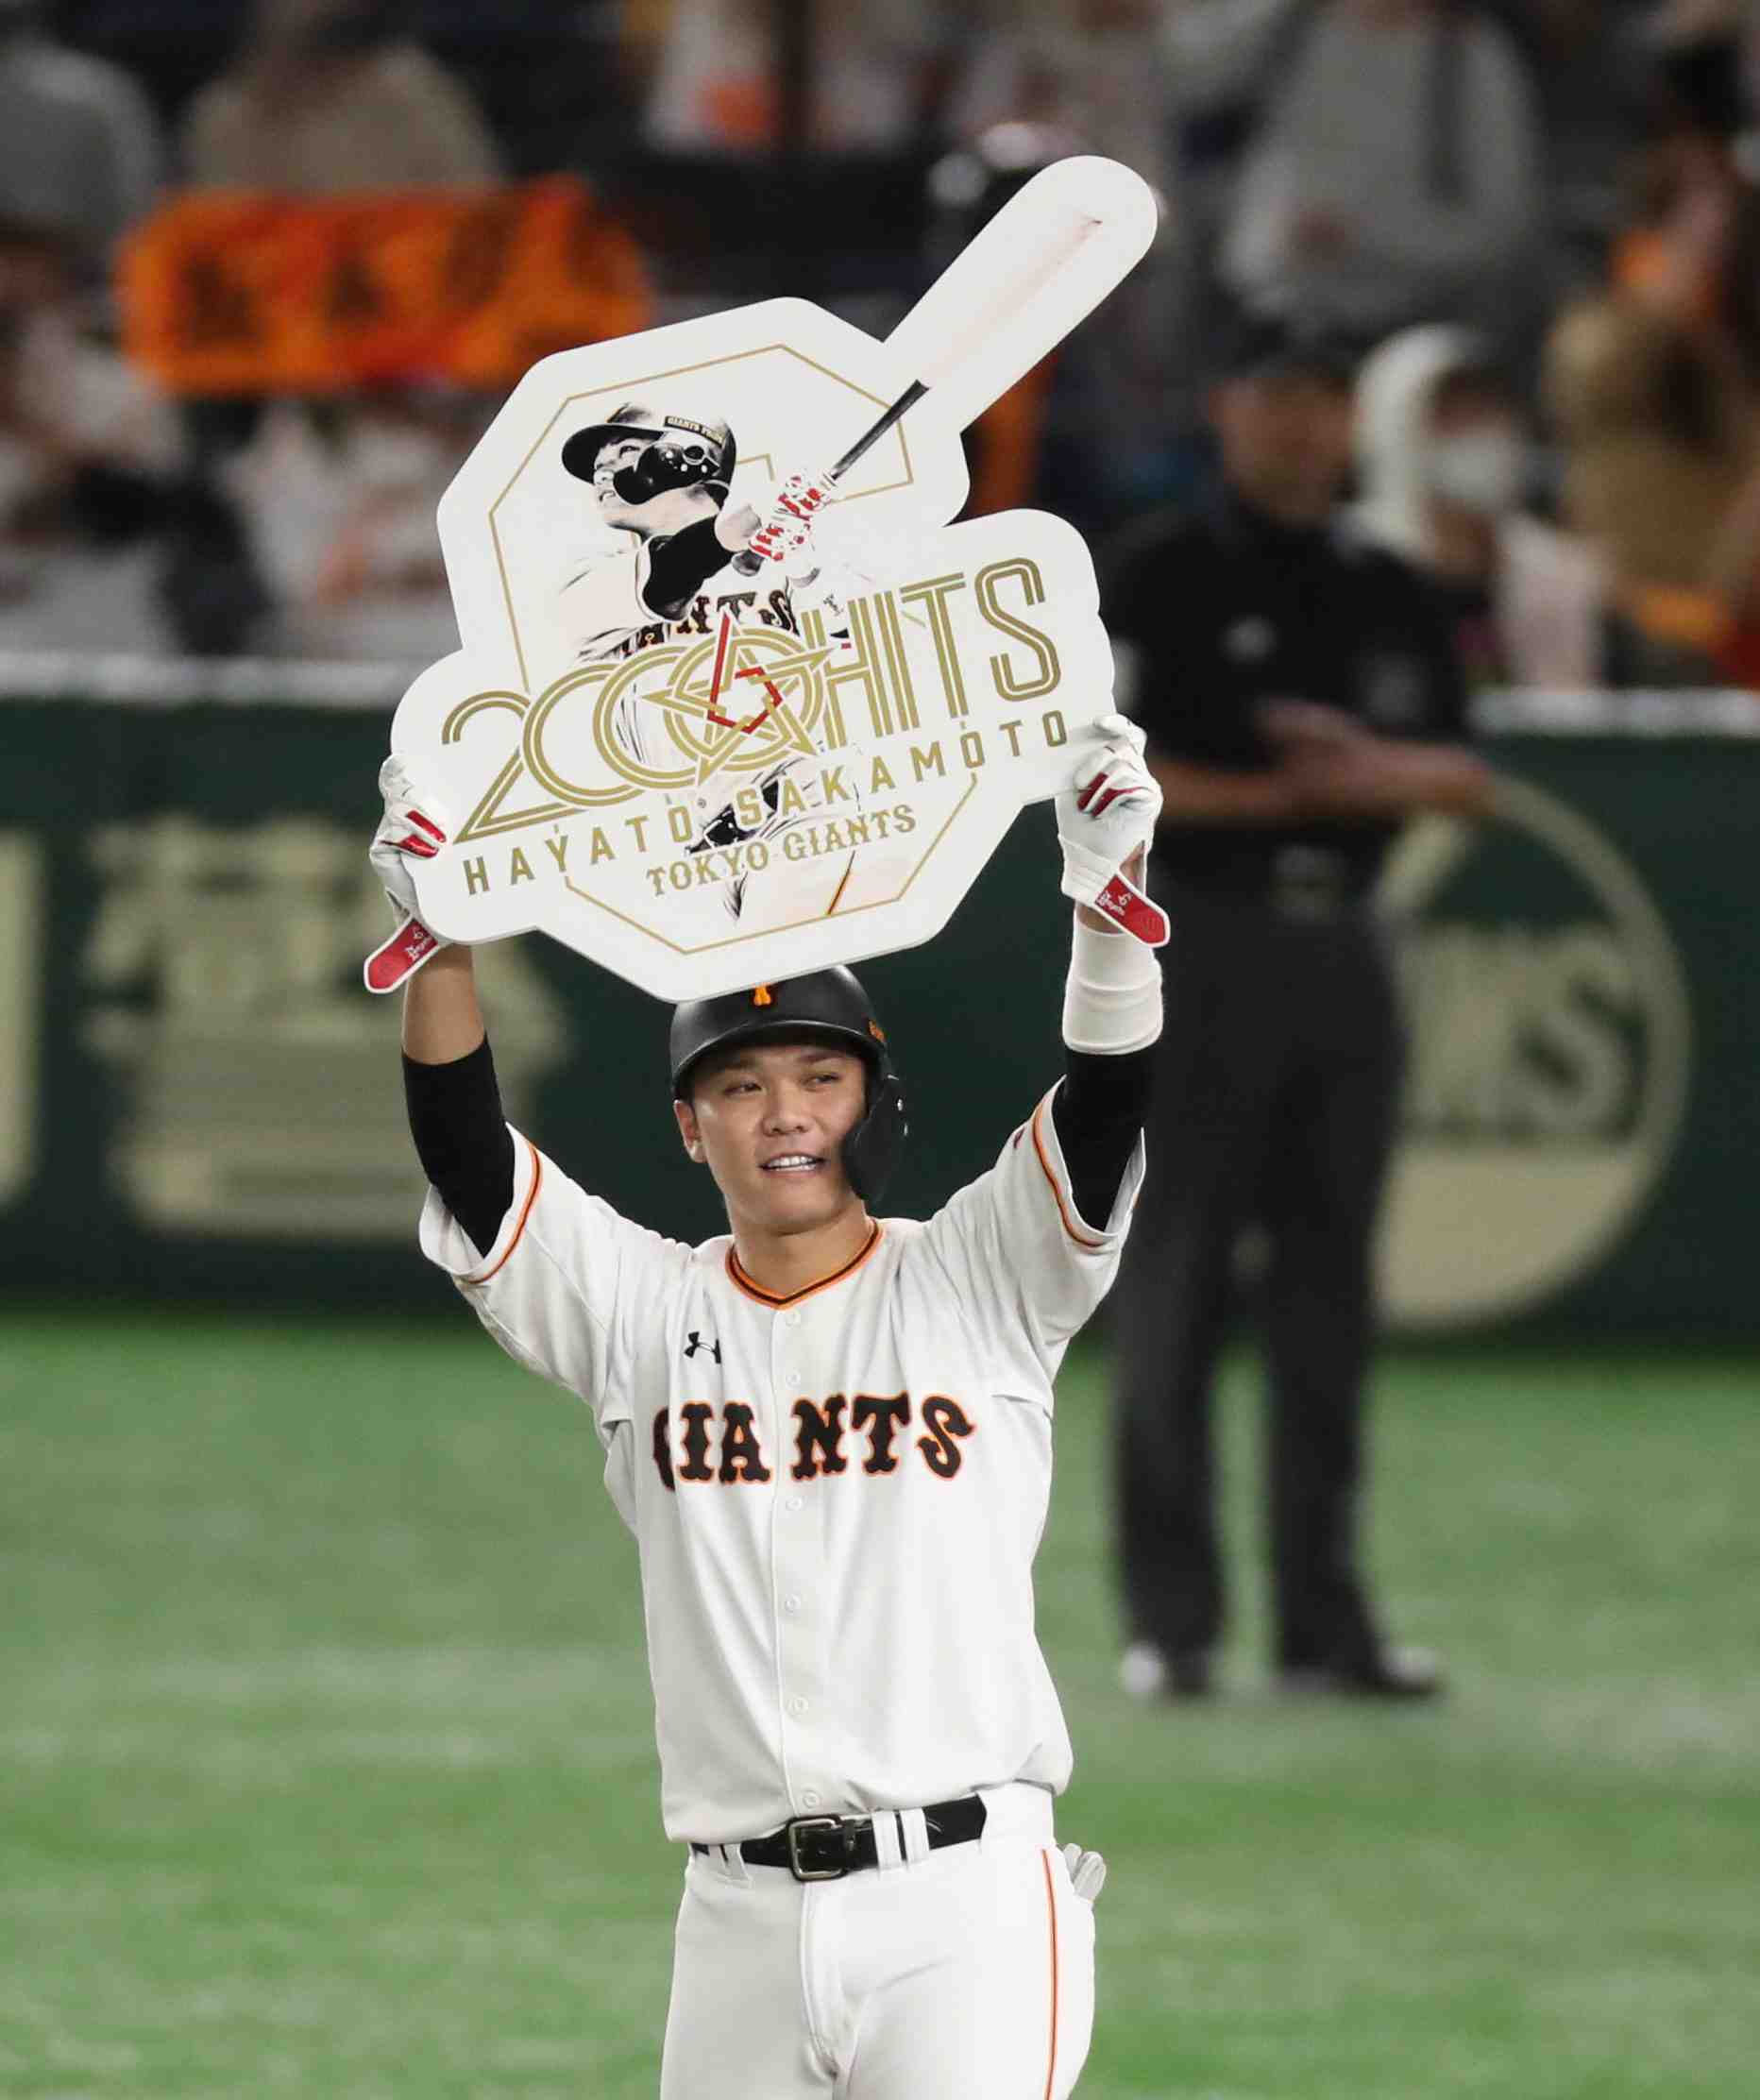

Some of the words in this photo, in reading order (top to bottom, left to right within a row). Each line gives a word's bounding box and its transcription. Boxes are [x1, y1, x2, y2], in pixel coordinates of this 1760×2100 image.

[800, 557, 1061, 752] HITS
[462, 804, 693, 896] HAYATO
[735, 708, 1069, 827] SAKAMOTO
[646, 839, 770, 897] TOKYO
[782, 804, 917, 862] GIANTS
